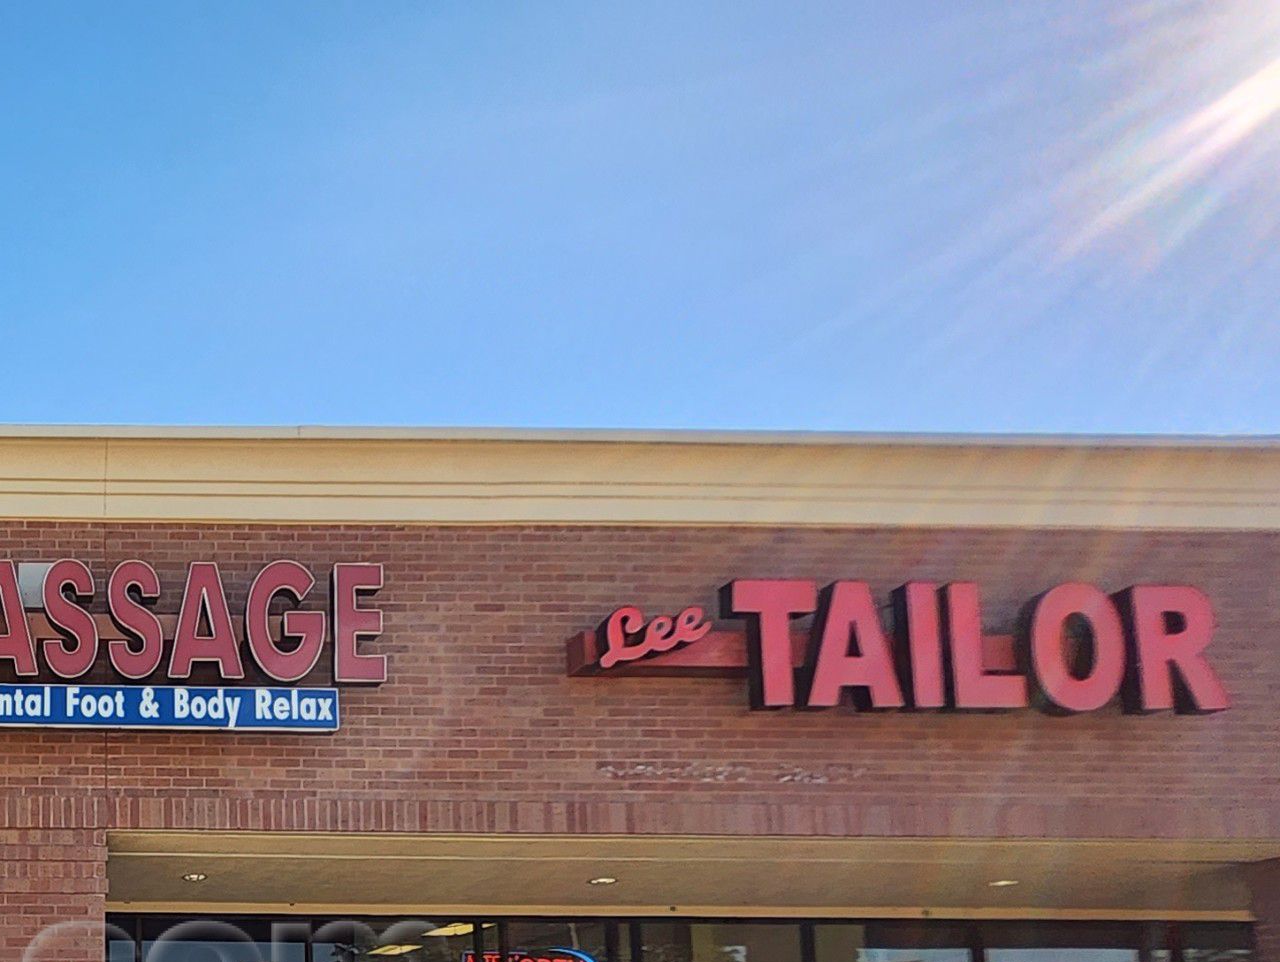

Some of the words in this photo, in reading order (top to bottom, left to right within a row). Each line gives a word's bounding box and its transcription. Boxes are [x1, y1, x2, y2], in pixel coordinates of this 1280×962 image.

[600, 606, 712, 669] Lee
[731, 580, 1230, 712] TAILOR
[66, 687, 125, 718] Foot
[138, 686, 160, 719] &
[174, 688, 242, 728] Body
[254, 689, 334, 722] Relax
